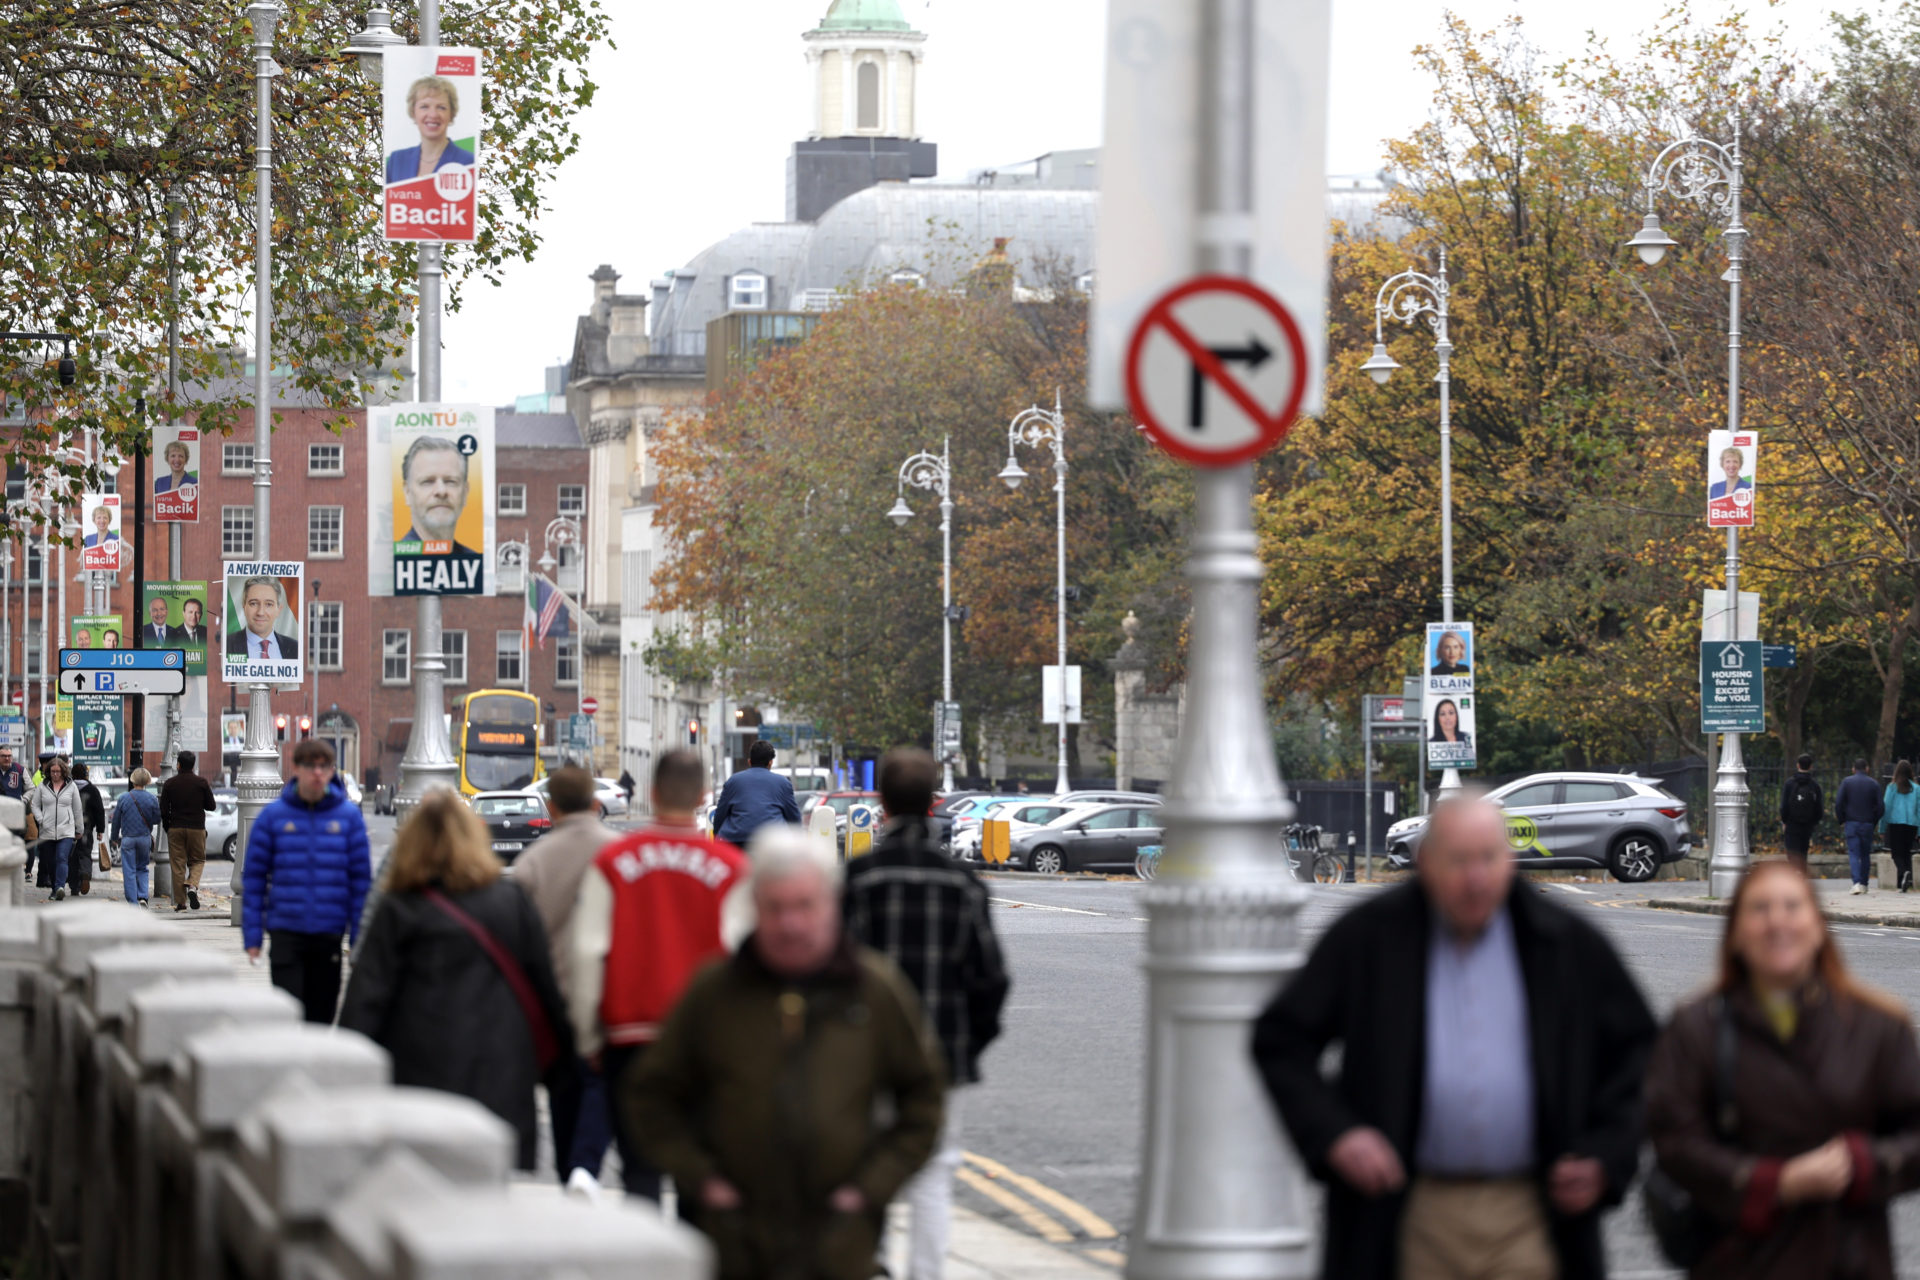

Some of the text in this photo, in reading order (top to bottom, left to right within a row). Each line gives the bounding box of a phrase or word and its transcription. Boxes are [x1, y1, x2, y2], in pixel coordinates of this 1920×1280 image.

[441, 173, 467, 190] VOTE 1
[388, 189, 422, 200] Ivana
[389, 203, 467, 225] Bacik
[394, 408, 457, 427] AONTÚ
[461, 437, 474, 454] 1
[157, 502, 194, 514] Bacik
[1711, 508, 1749, 519] Bacik
[424, 543, 448, 552] ALAN
[86, 554, 116, 564] Bacik
[227, 563, 300, 576] A NEW ENERGY
[396, 559, 481, 590] HEALY
[110, 653, 135, 666] J10
[229, 655, 247, 663] VOTE
[225, 665, 298, 678] FINE GAEL NO.1
[1711, 671, 1753, 679] HOUSING
[1430, 679, 1471, 689] BLAIN
[1715, 678, 1728, 686] for
[1715, 687, 1750, 695] EXCEPT
[1714, 694, 1728, 702] for
[1430, 749, 1468, 759] DOYLE
[1507, 826, 1532, 838] TAXI
